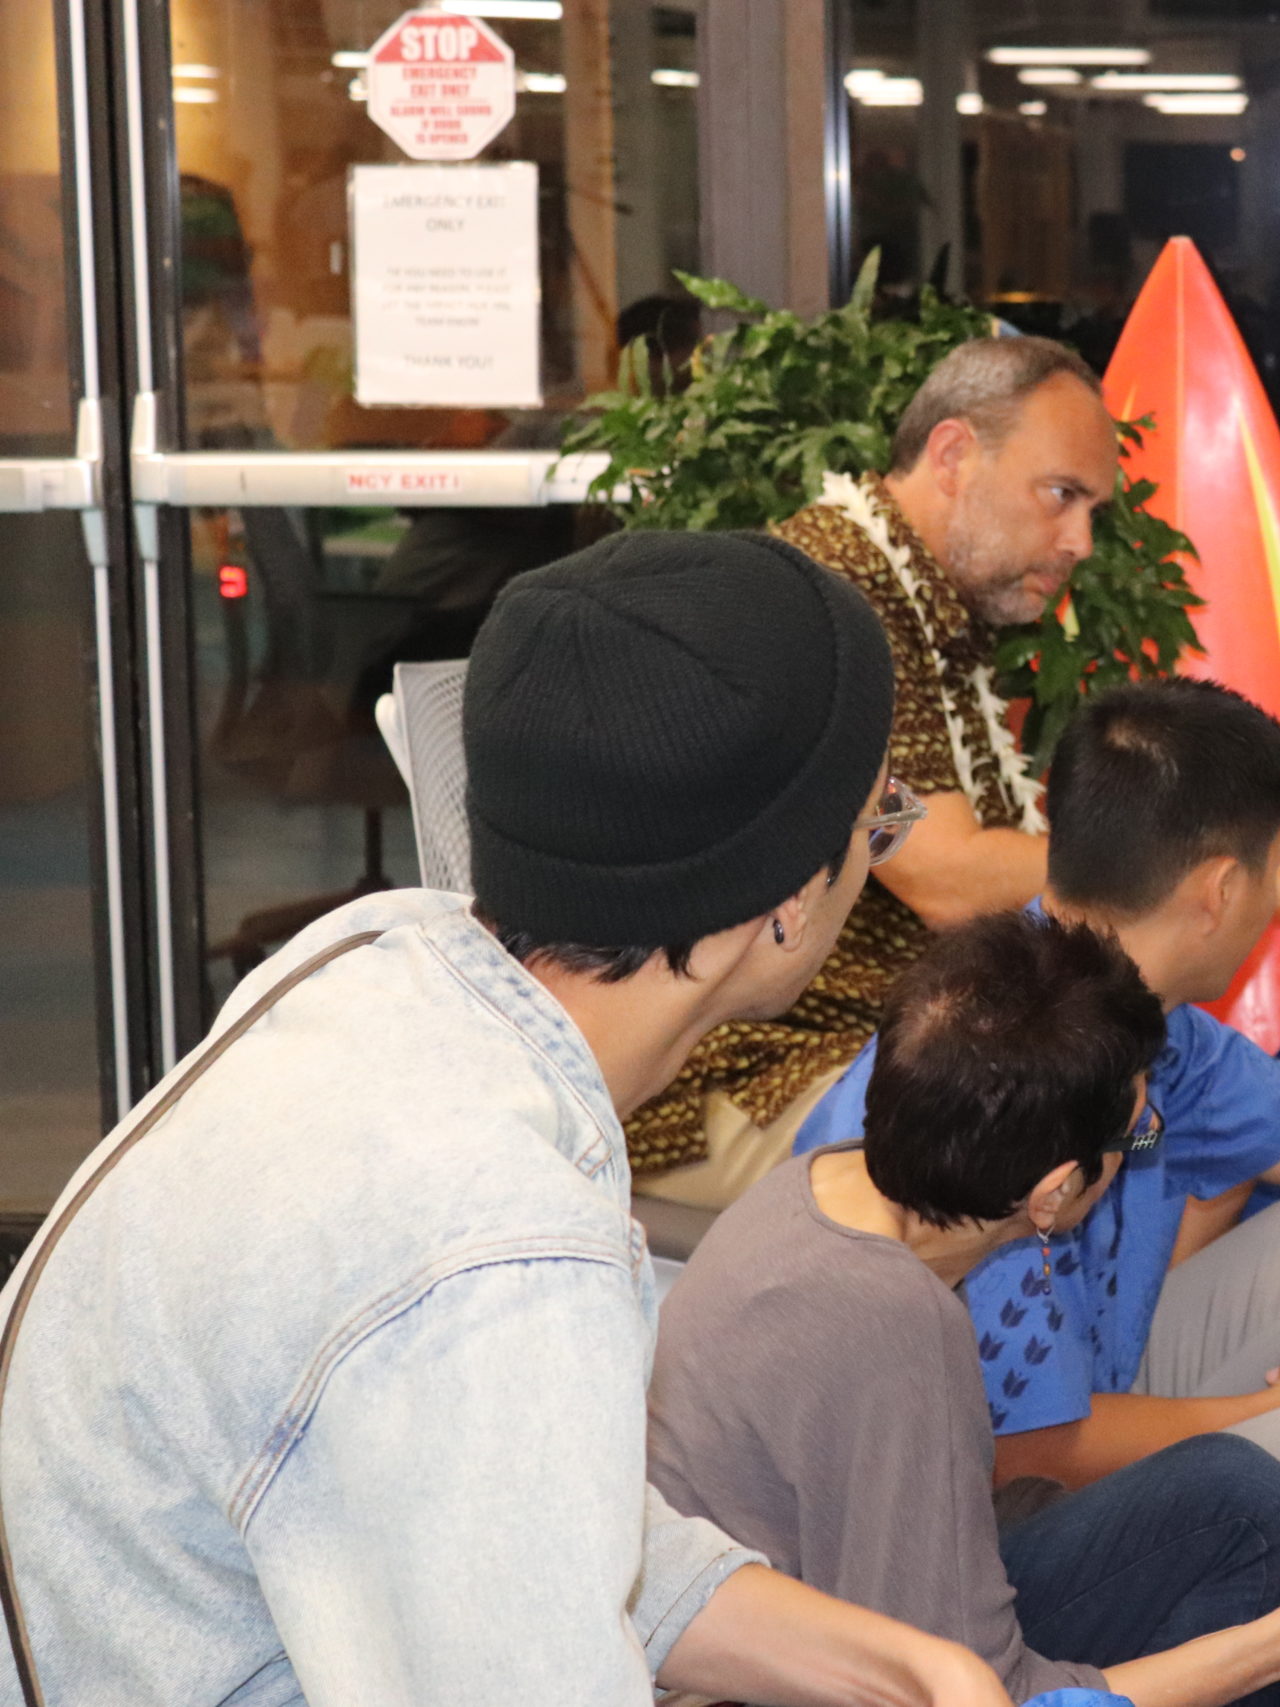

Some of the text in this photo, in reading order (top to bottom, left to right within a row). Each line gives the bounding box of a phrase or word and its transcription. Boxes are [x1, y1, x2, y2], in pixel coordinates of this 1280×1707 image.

[401, 25, 478, 62] STOP
[402, 67, 477, 80] EMERGENCY
[410, 84, 436, 97] EXIT
[425, 217, 466, 233] ONLY
[349, 472, 392, 489] NCY
